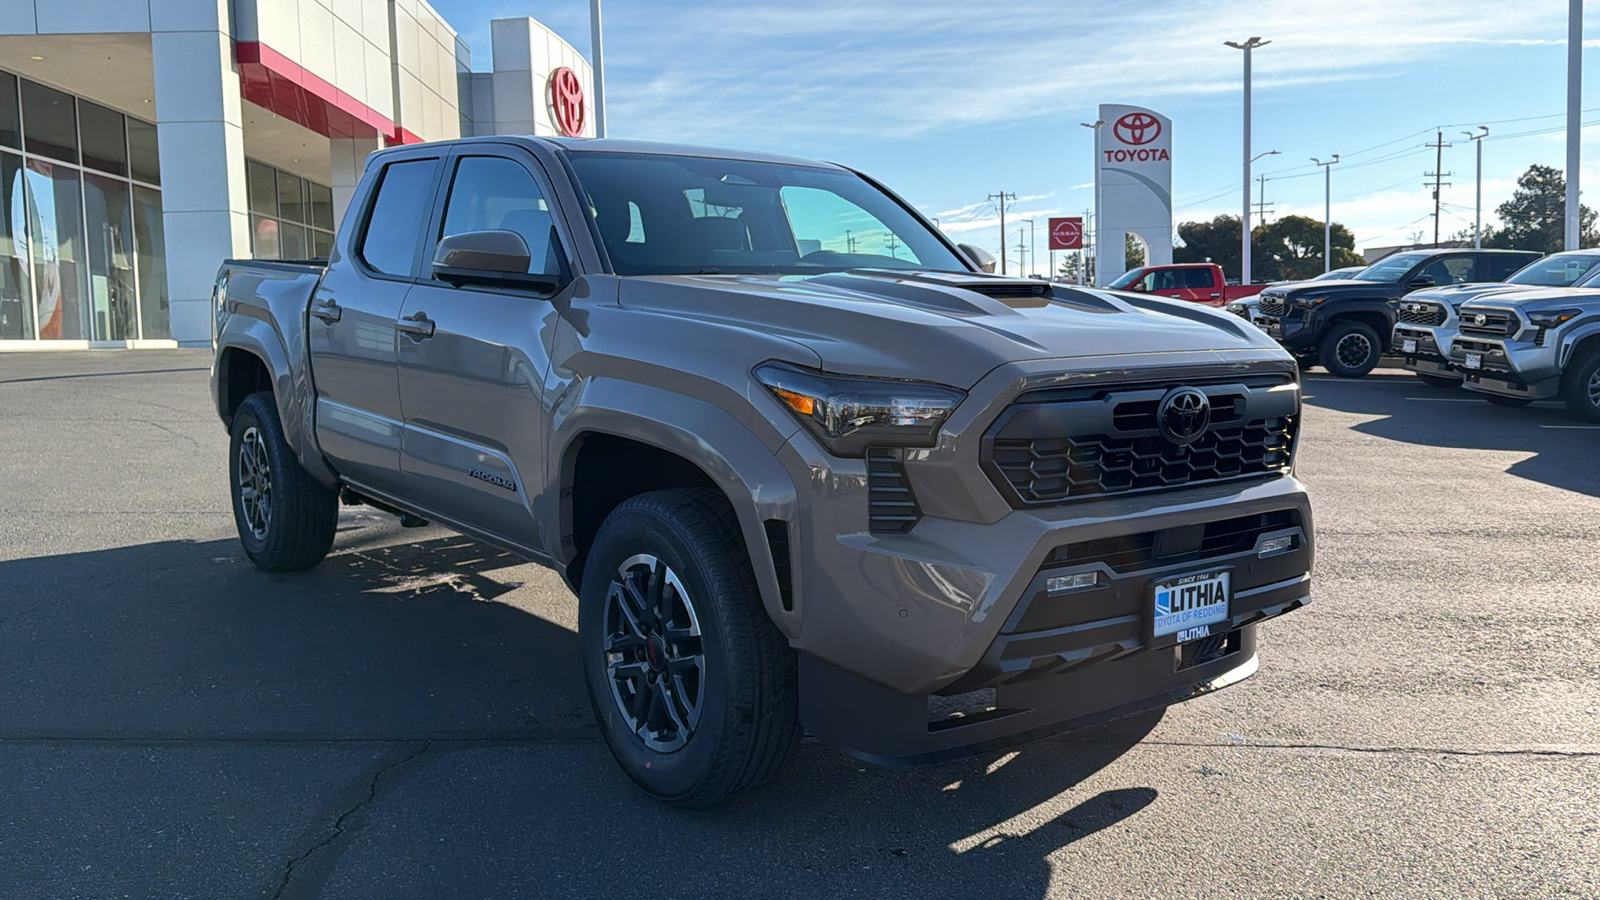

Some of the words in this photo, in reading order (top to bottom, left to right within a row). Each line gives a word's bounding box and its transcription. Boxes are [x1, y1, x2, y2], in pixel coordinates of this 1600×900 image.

[1104, 149, 1169, 162] TOYOTA
[467, 468, 516, 492] TACOMA
[1178, 576, 1196, 585] SINCE
[1171, 581, 1225, 613] LITHIA
[1182, 612, 1191, 622] OF
[1194, 604, 1225, 619] REDDING
[1184, 625, 1209, 639] LITHIA
